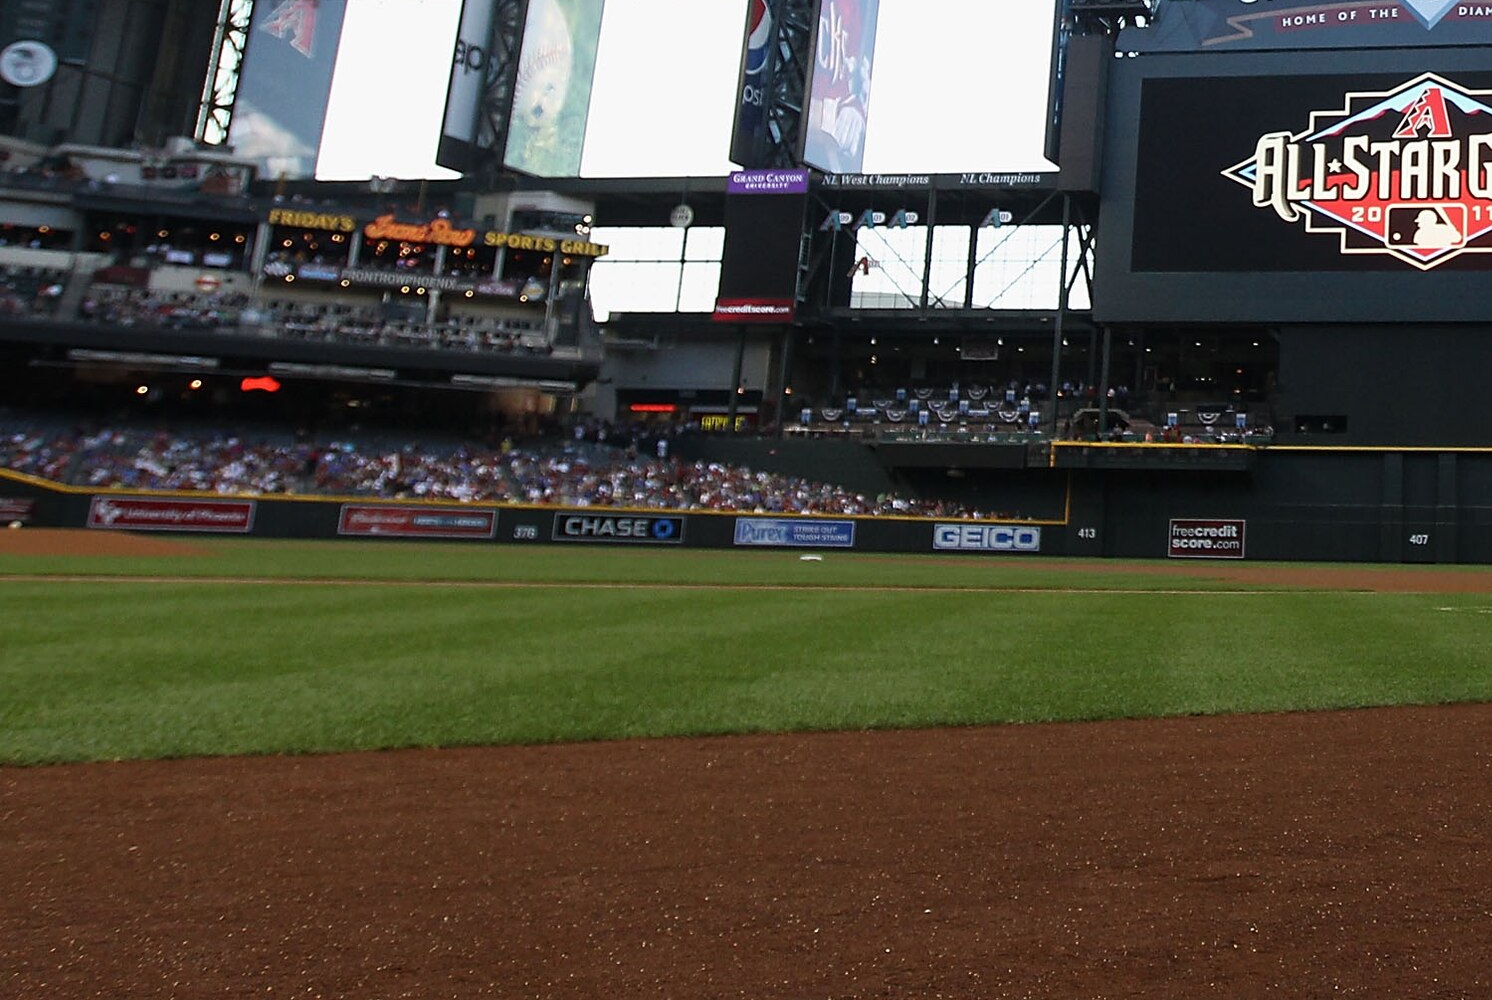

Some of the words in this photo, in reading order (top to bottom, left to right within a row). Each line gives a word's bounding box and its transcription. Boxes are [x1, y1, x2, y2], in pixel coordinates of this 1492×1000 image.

[1282, 13, 1326, 27] HOME
[1338, 10, 1358, 22] OF
[1369, 8, 1399, 19] THE
[733, 173, 764, 183] GRAND
[766, 173, 803, 183] CANYON
[822, 175, 838, 185] NL
[840, 174, 867, 185] West
[869, 174, 930, 187] Champions
[960, 173, 978, 184] NL
[979, 172, 1041, 186] Champions
[1254, 131, 1340, 222] ALL
[1340, 135, 1461, 200] STAR
[269, 209, 356, 232] FRIDAY'S
[1352, 206, 1382, 222] 20
[484, 230, 557, 253] SPORTS
[513, 525, 536, 539] 376
[565, 517, 648, 537] CHASE
[741, 521, 787, 544] Purex
[1077, 528, 1096, 539] 413
[1172, 524, 1238, 537] freecredit
[935, 526, 1040, 549] GEICO
[1171, 538, 1240, 549] score.com
[1409, 534, 1428, 545] 407
